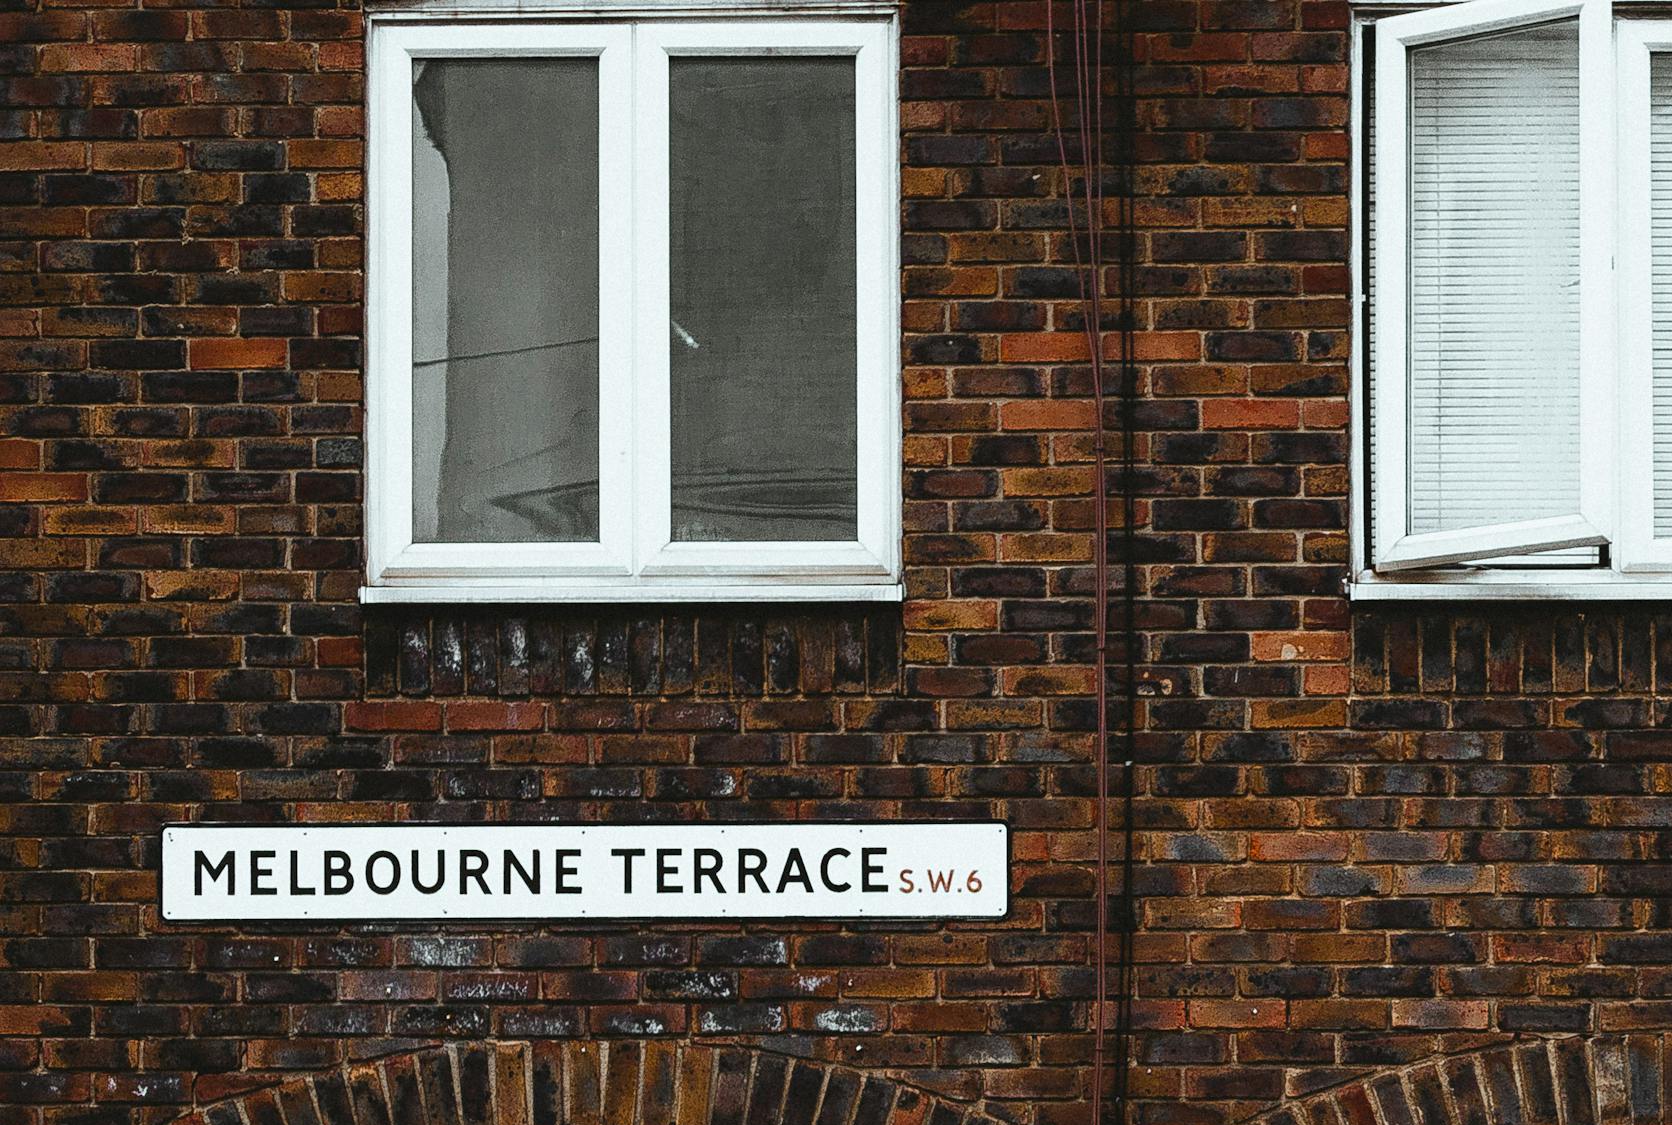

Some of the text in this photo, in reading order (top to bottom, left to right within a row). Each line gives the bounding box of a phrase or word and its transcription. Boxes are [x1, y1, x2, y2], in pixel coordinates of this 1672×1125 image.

[193, 847, 983, 897] MELBOURNE TERRACE S.W.6
